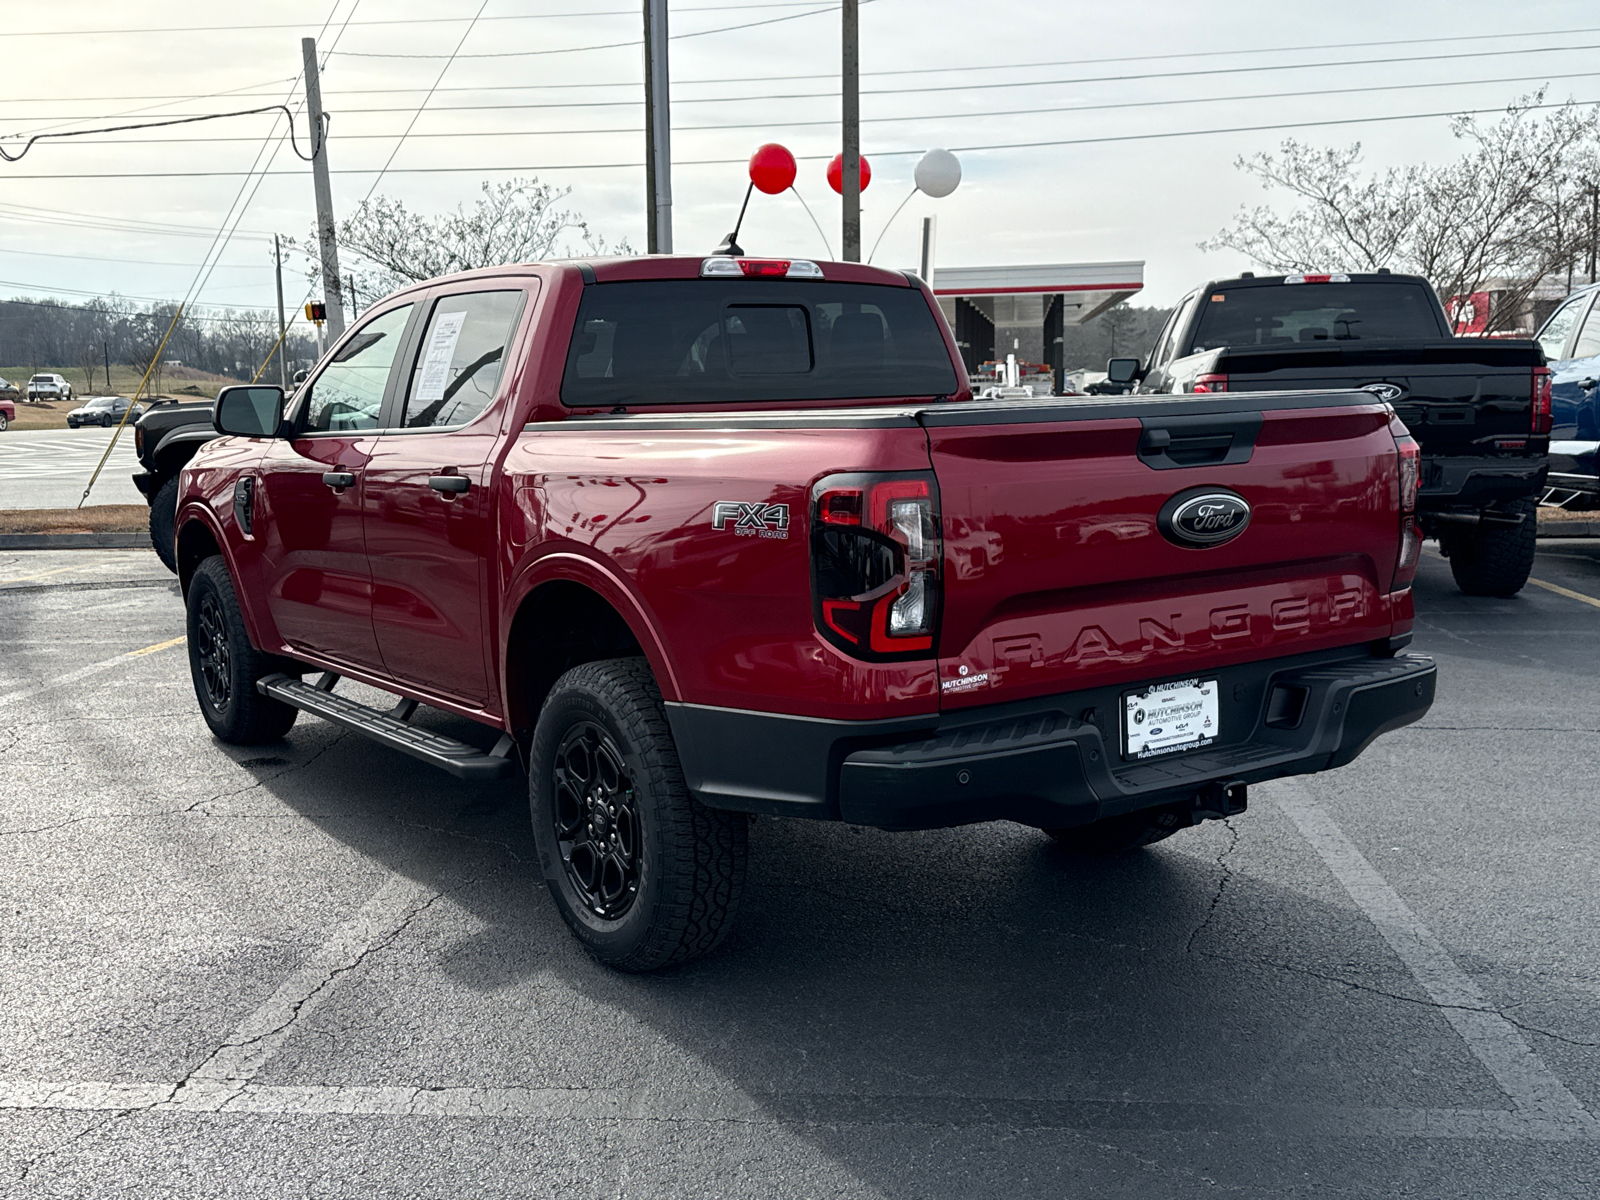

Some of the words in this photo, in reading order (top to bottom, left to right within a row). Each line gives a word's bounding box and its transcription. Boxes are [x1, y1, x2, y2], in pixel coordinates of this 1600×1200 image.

[712, 500, 790, 530] FX4
[1193, 504, 1235, 530] Ford
[734, 528, 756, 537] OFF
[758, 529, 789, 539] ROAD
[992, 587, 1366, 673] RANGER
[942, 673, 988, 690] HUTCHINSON
[1155, 677, 1199, 693] HUTCHINSON
[560, 696, 595, 711] TERRITORY
[1147, 700, 1203, 720] HUTCHINSON
[1147, 715, 1181, 727] AUTOMOTIVE
[1182, 711, 1201, 721] GROUP
[1137, 738, 1213, 759] Hutchinsonautogroup.com
